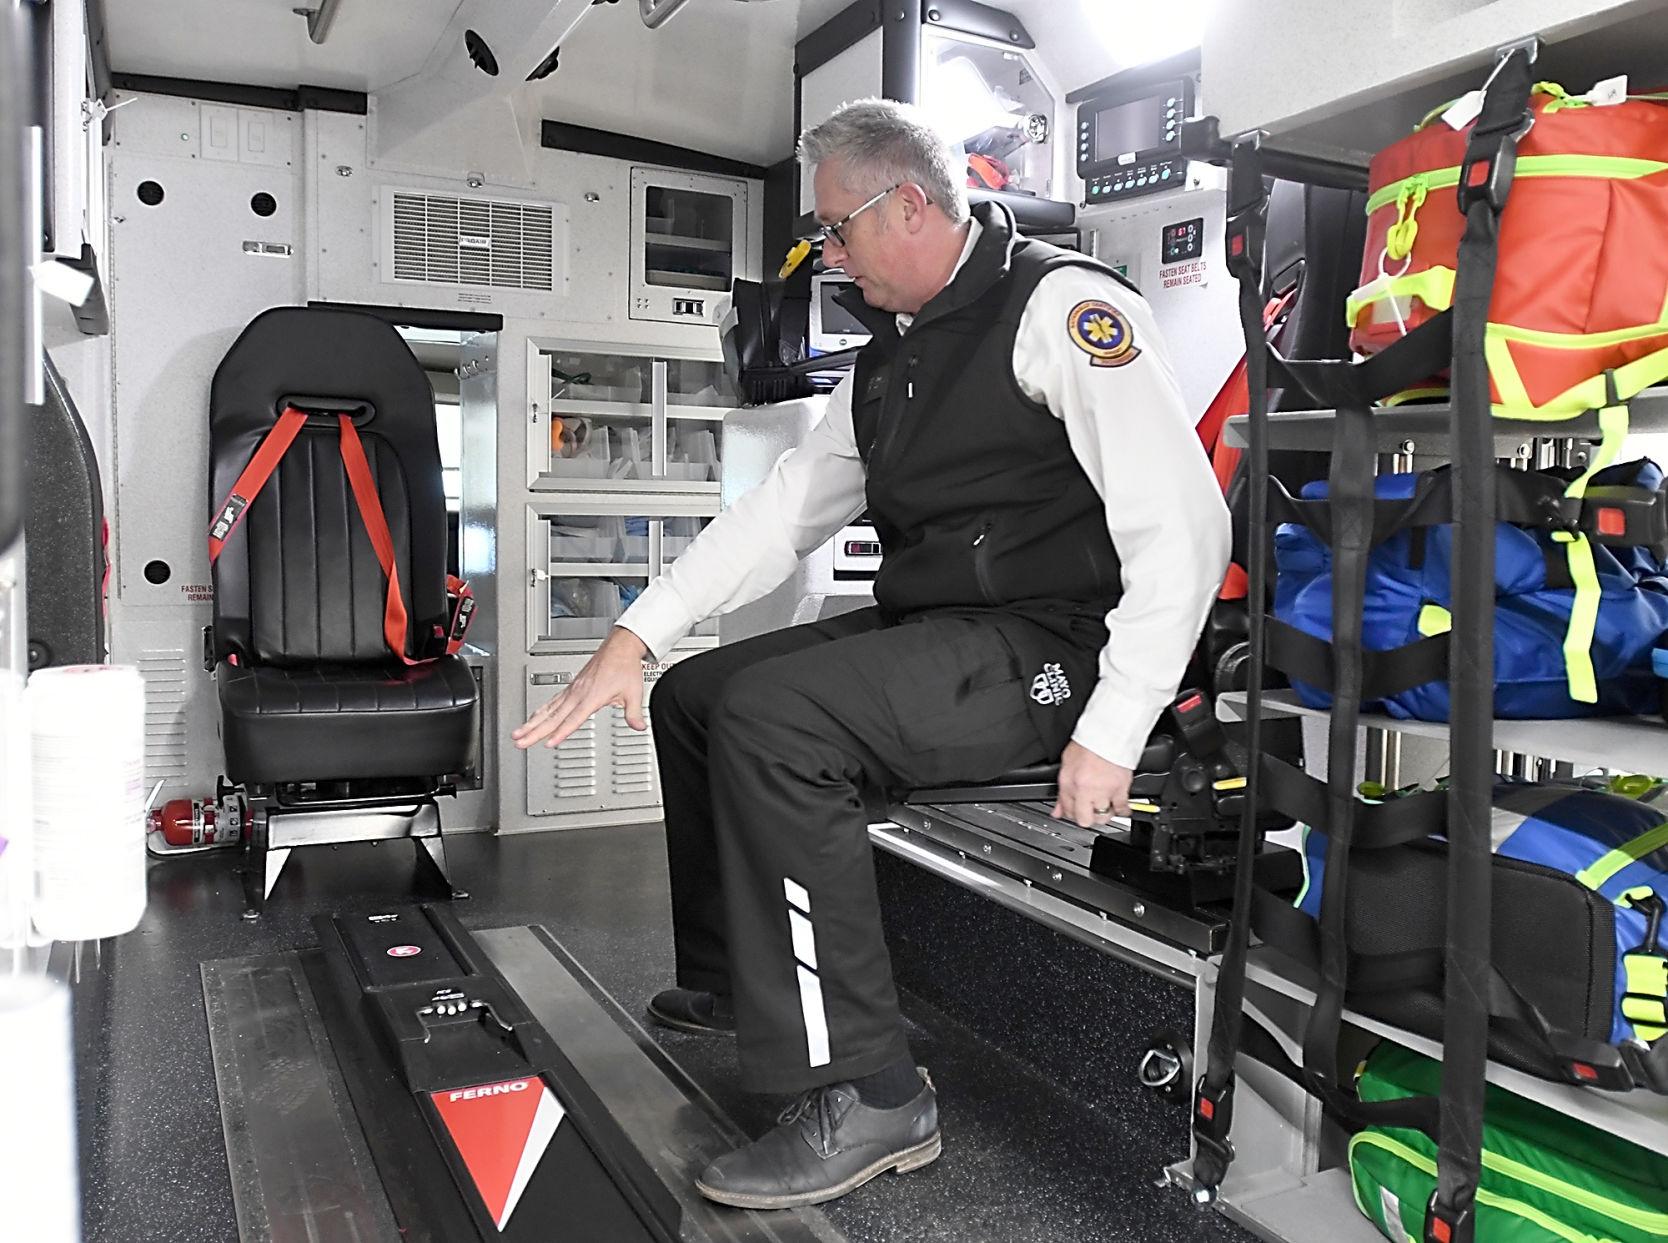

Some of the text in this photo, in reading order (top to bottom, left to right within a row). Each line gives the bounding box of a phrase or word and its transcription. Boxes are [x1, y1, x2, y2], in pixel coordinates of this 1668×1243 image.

[1160, 261, 1207, 279] FASTEN SEAT BELTS
[1163, 273, 1202, 289] REMAIN SEATED
[181, 584, 207, 593] FASTEN
[1044, 663, 1064, 706] CLINIC
[1050, 663, 1071, 699] MAYO
[450, 1081, 529, 1102] FERNO
